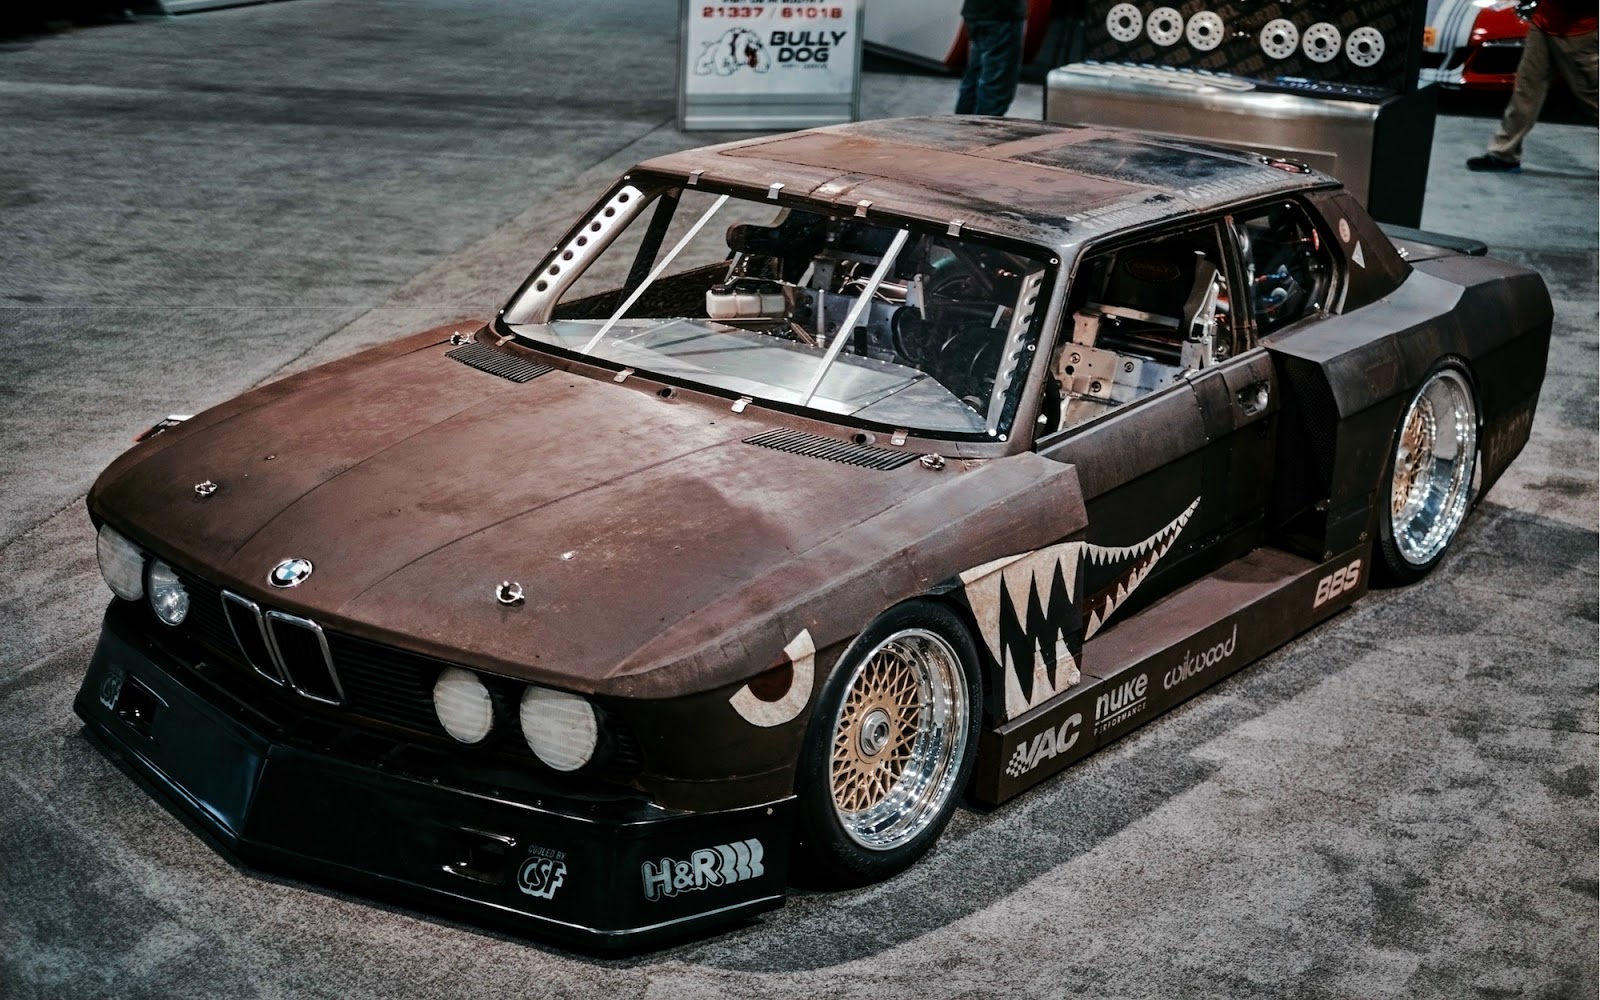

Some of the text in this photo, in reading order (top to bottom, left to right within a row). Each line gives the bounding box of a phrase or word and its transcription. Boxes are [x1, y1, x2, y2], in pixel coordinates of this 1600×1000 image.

[702, 6, 764, 18] 21337
[781, 7, 843, 18] 61018
[770, 31, 847, 46] BULLY
[777, 48, 830, 63] DOG
[1313, 559, 1361, 609] BBS
[1163, 624, 1237, 690] wilwood
[1095, 673, 1148, 721] nuke
[1011, 713, 1082, 776] VAC
[528, 844, 567, 861] COOLED BY
[641, 848, 726, 901] H&R
[517, 856, 567, 900] CSF
